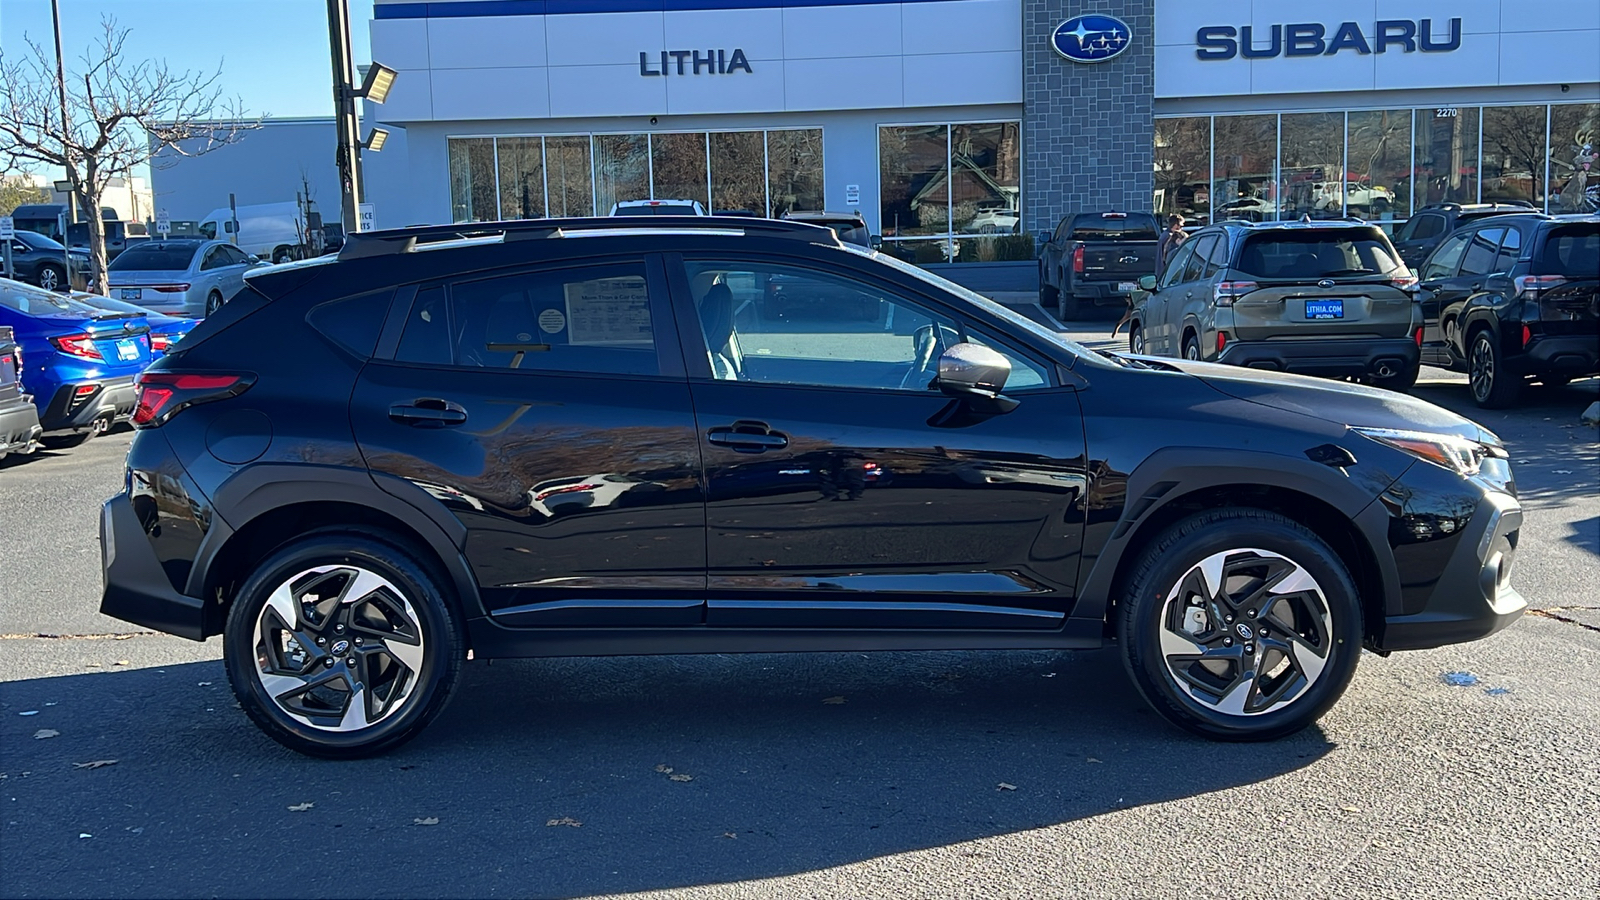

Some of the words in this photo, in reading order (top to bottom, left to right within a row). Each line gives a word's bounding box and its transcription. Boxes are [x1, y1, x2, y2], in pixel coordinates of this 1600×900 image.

[1196, 17, 1462, 60] SUBARU
[639, 48, 753, 76] LITHIA
[1436, 108, 1457, 118] 2270
[1306, 305, 1342, 313] LITHIA.COM
